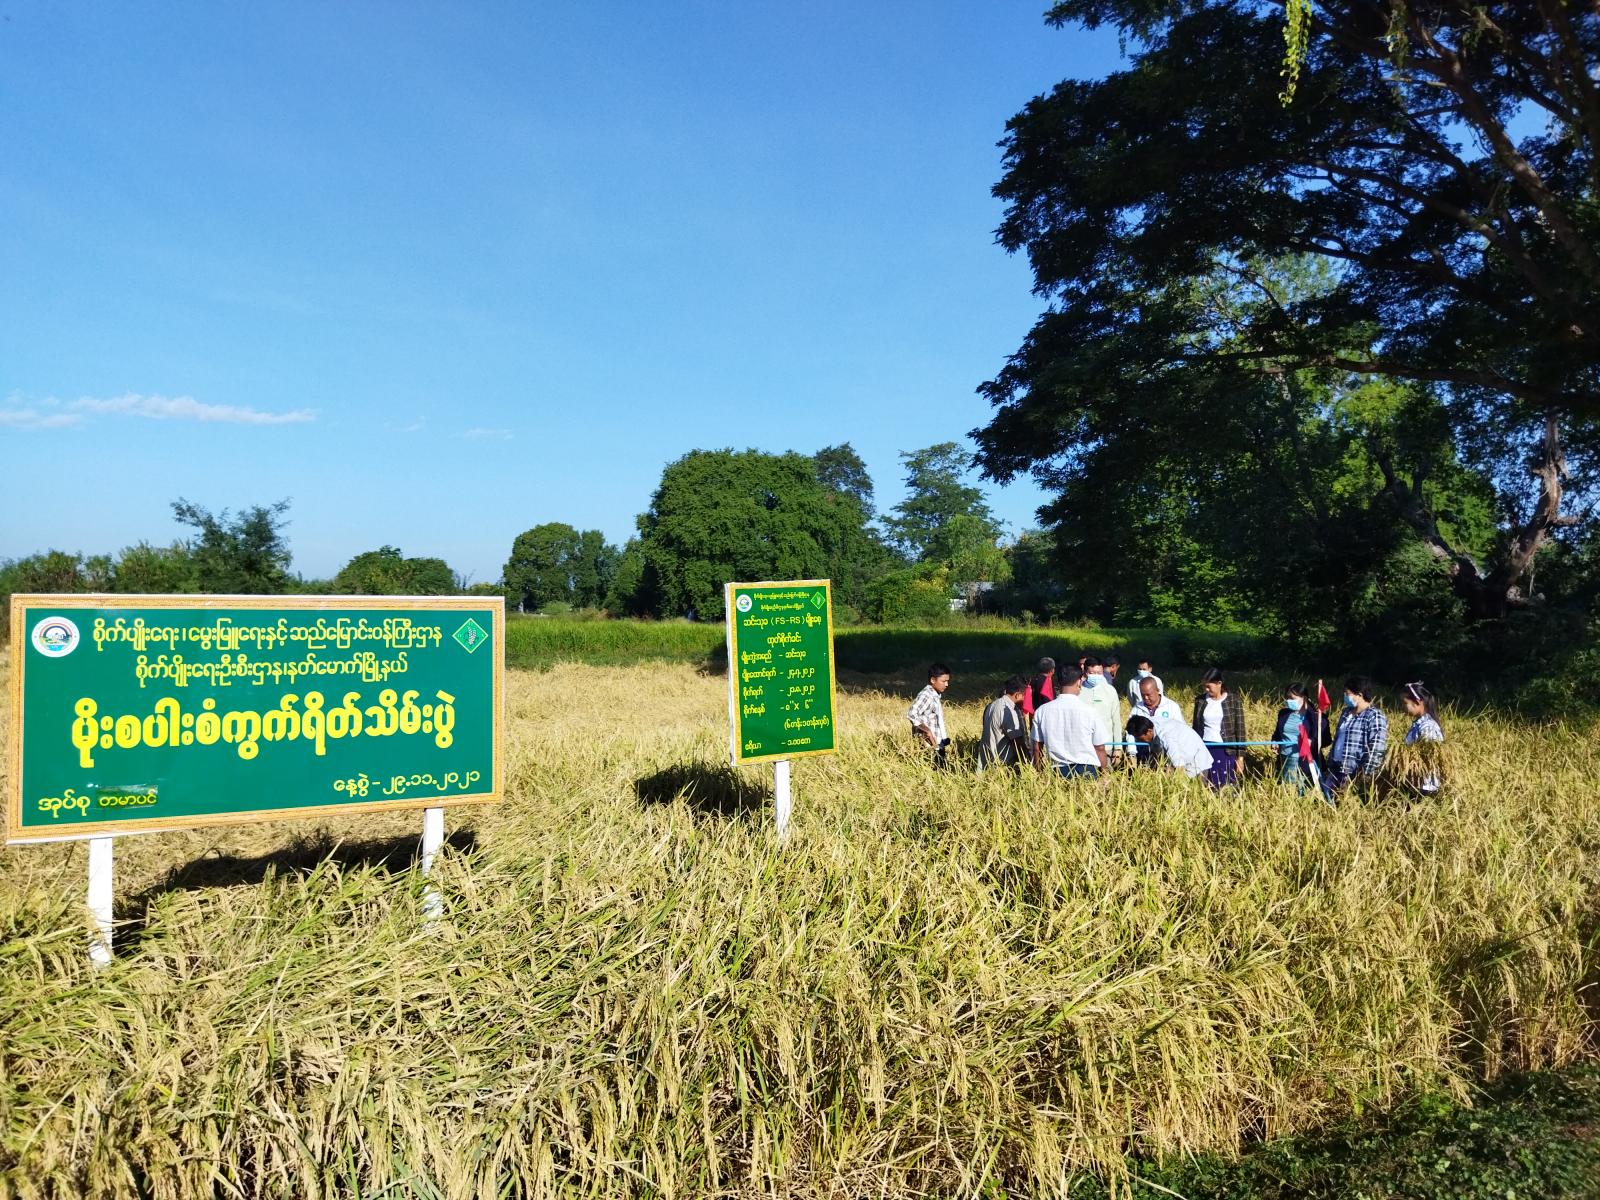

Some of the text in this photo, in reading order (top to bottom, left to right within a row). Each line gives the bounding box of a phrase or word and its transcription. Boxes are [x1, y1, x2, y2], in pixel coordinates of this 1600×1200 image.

[72, 687, 455, 768] မိုးစပါးစံကွက်ရိတ်သိမ်းပွဲ
[383, 771, 482, 796] ၂၉.၁၁.၂၀၂၁
[39, 788, 157, 818] အုပ်စု တမာပင်
